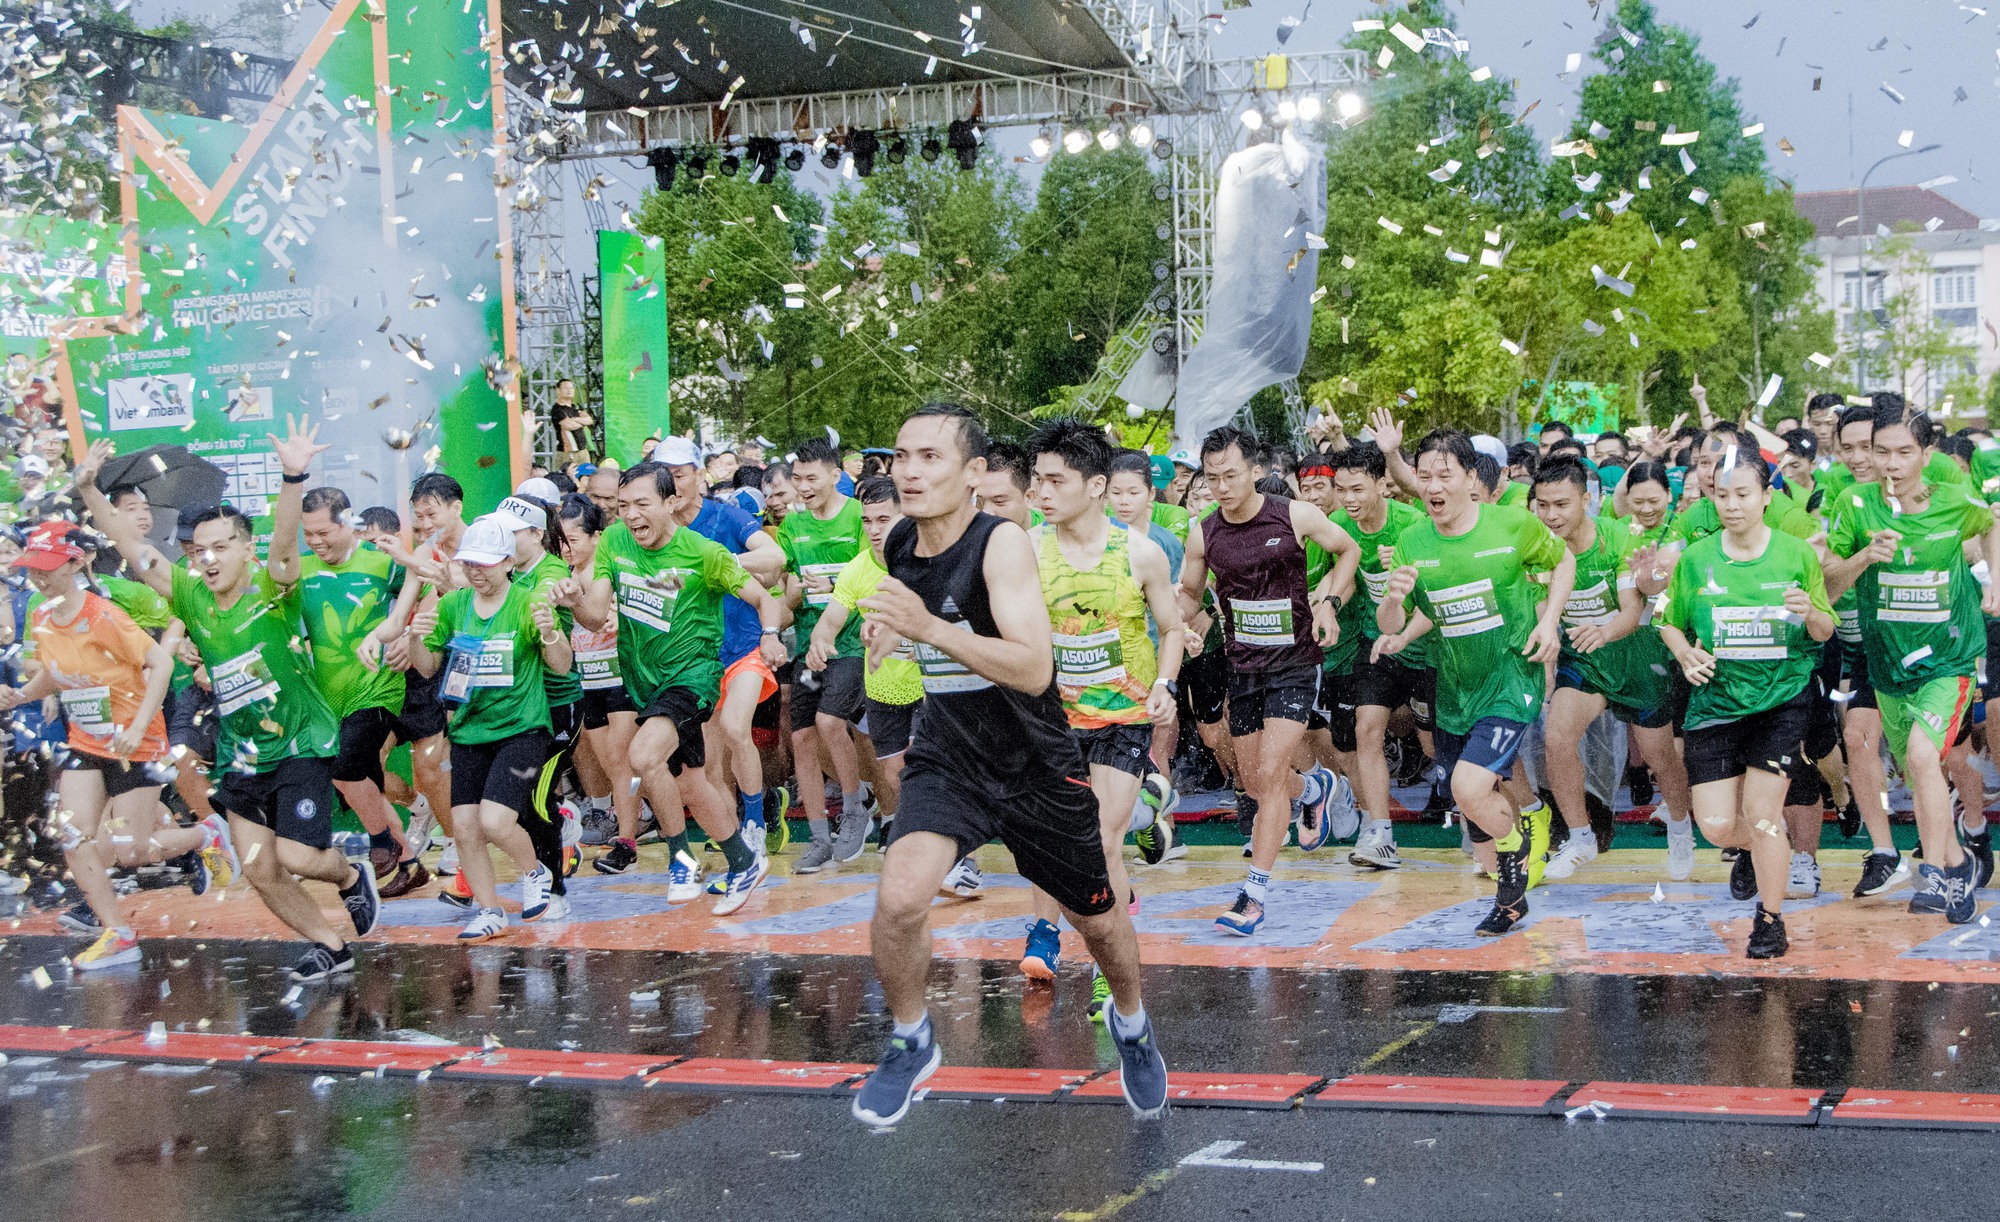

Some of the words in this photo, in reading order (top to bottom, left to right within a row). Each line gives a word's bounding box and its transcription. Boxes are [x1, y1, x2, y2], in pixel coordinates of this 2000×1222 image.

[233, 80, 341, 236] START
[173, 296, 217, 309] MEKONG
[218, 293, 250, 305] DELTA
[251, 288, 311, 302] MARATHON
[211, 303, 263, 324] GIANG
[265, 300, 313, 319] 2023
[115, 405, 187, 419] Vietmbank
[629, 587, 665, 610] H51055
[1892, 588, 1937, 602] H51135
[1441, 596, 1485, 617] T53956
[1242, 613, 1281, 626] A50001
[1062, 647, 1109, 664] A50014
[1491, 726, 1516, 753] 17
